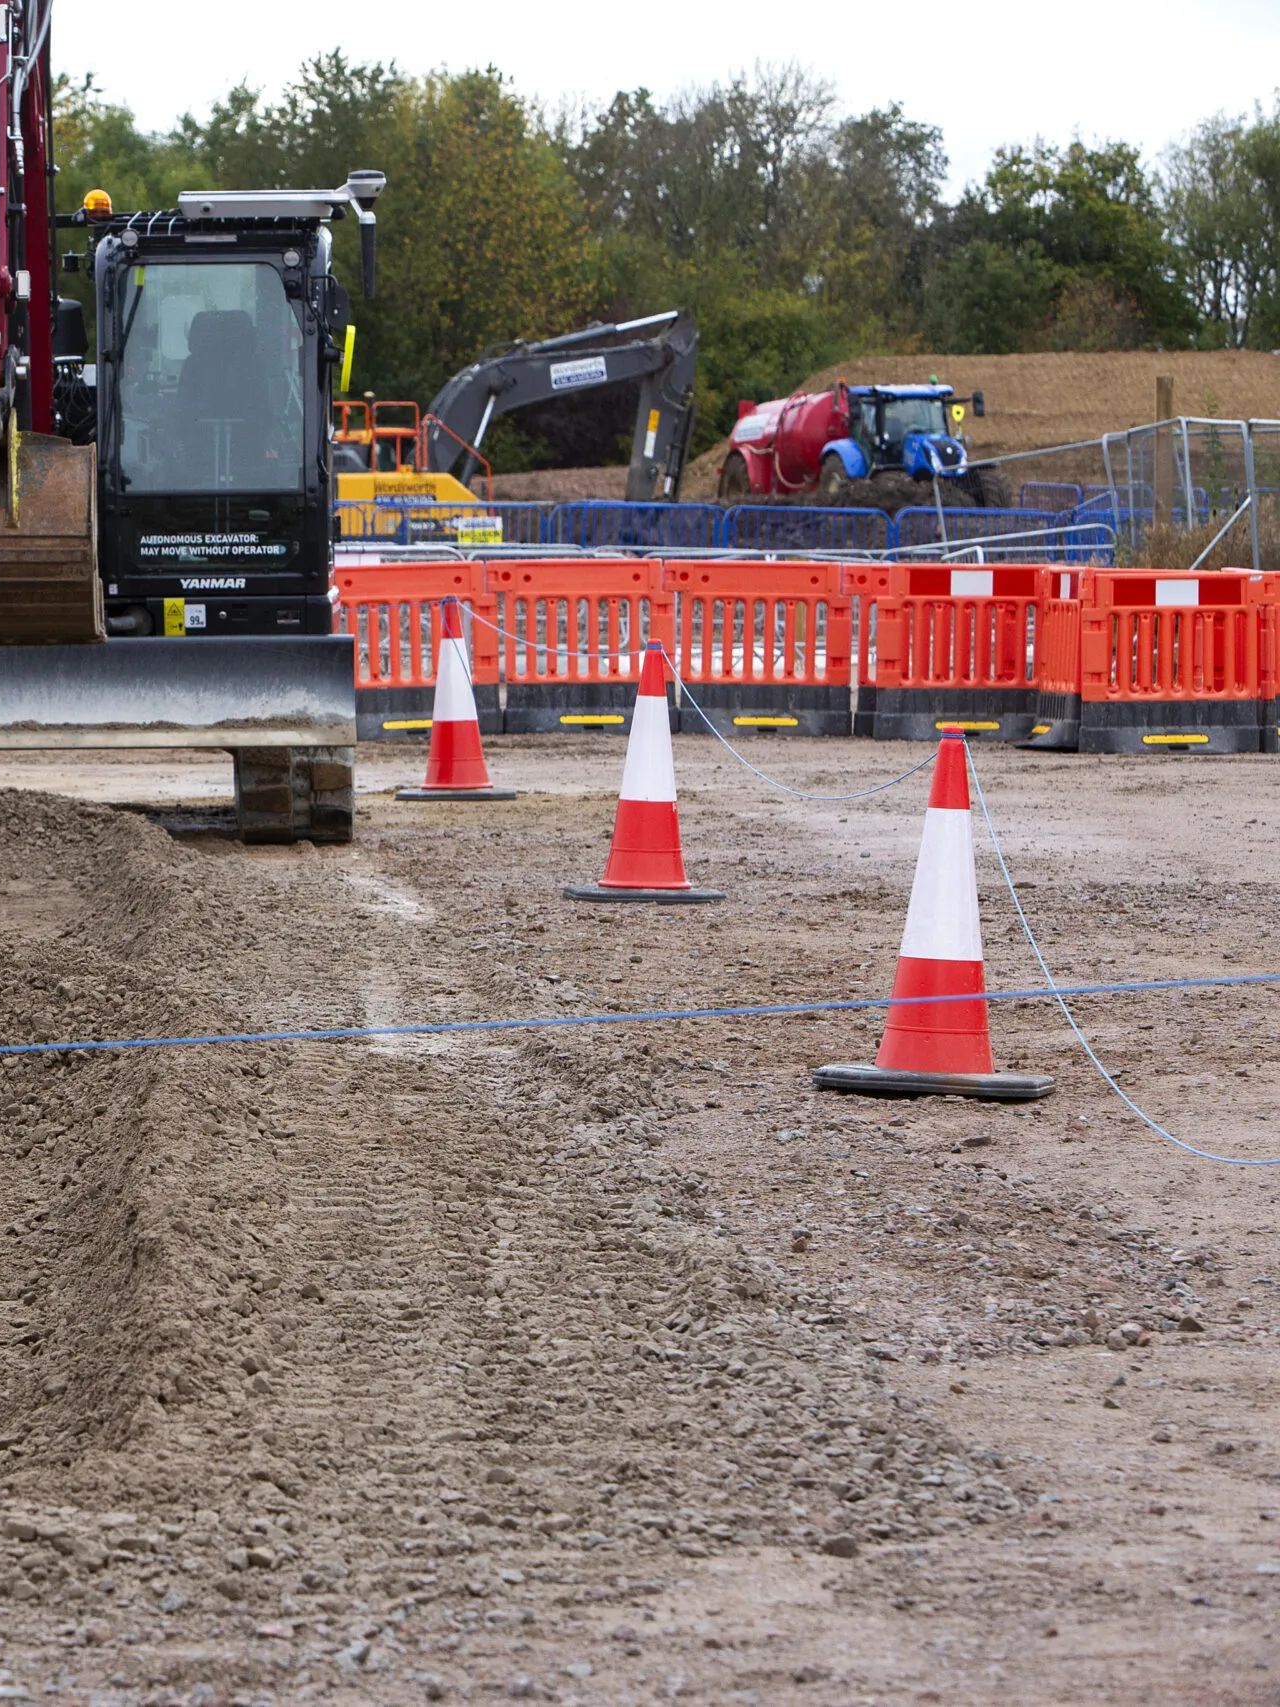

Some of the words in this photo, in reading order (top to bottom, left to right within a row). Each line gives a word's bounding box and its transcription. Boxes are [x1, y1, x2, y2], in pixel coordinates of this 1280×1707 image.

[140, 535, 203, 544] AUTONOMOUS
[204, 534, 259, 543] EXCAVATOR:
[140, 546, 161, 555] MAY
[161, 546, 187, 555] MOVE
[189, 546, 230, 555] WITHOUT
[231, 545, 280, 555] OPERATOR
[180, 578, 246, 589] YANMAR
